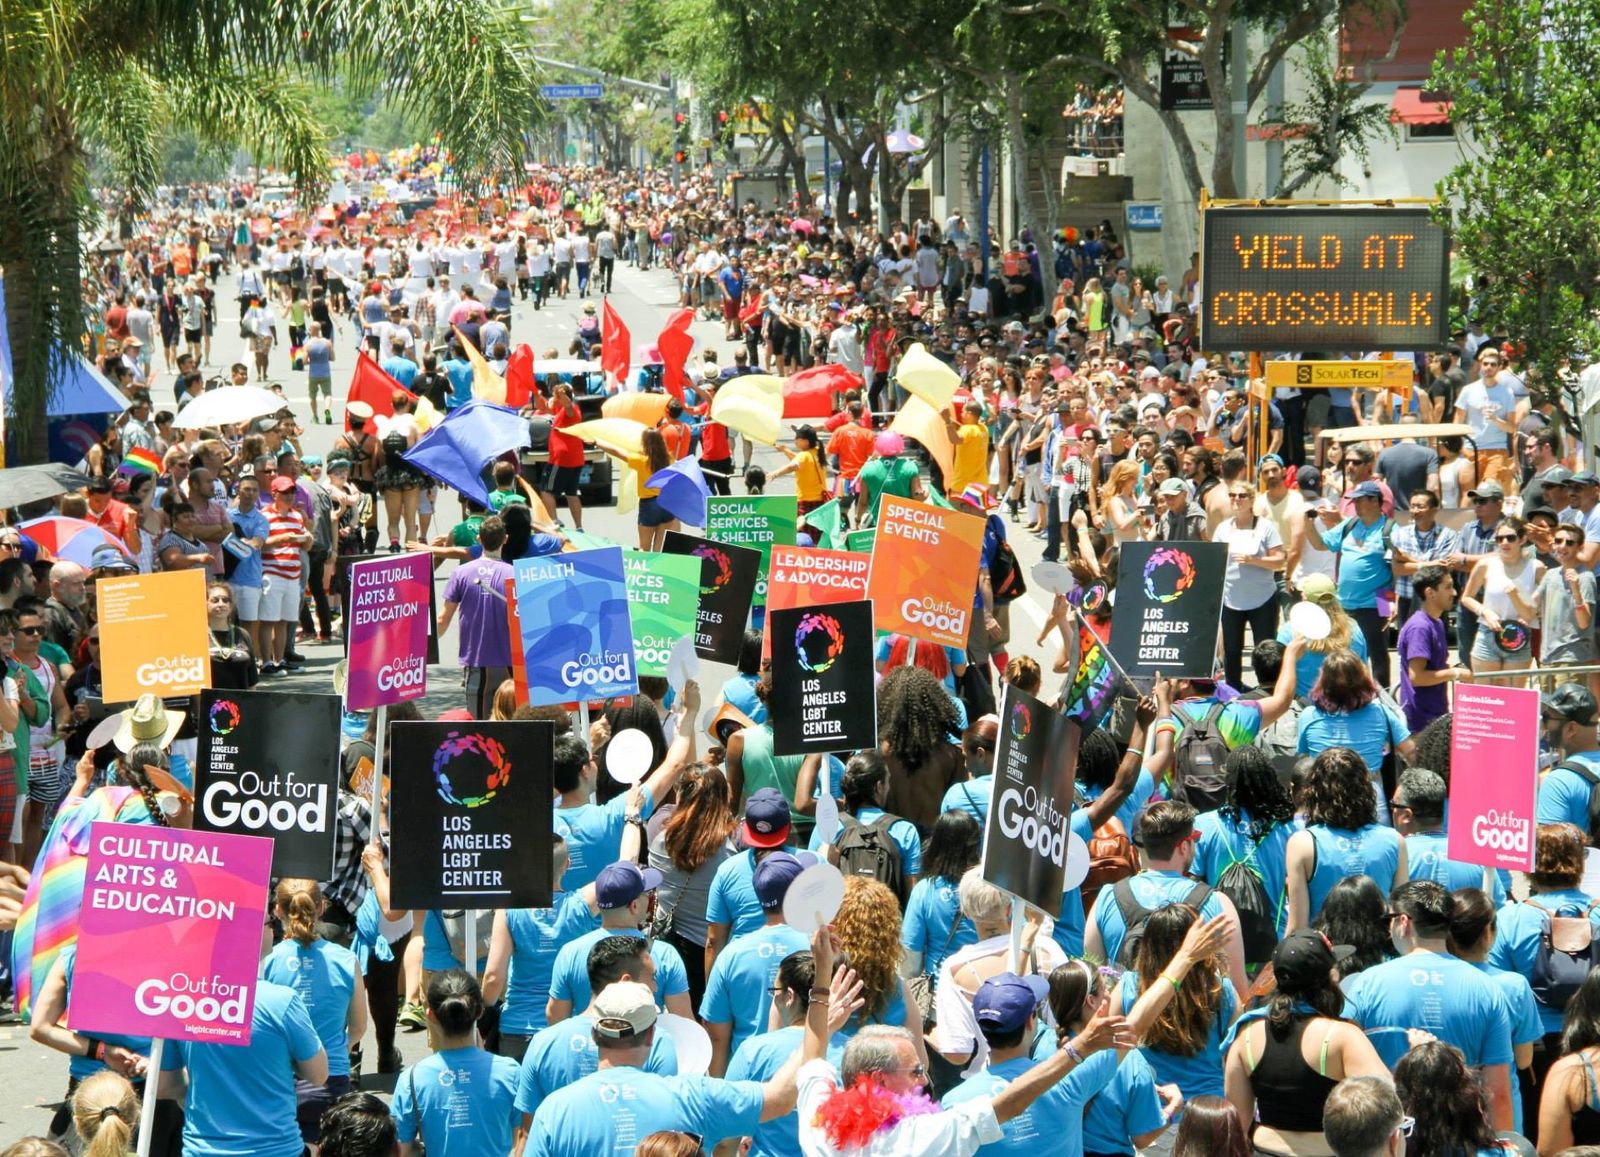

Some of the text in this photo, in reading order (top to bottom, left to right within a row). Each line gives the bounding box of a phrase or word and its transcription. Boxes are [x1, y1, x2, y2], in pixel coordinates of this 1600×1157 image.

[1172, 71, 1192, 83] JUNE
[1233, 233, 1415, 270] YIELD AT
[1212, 290, 1433, 327] CROSSWALK
[710, 503, 757, 515] SOCIAL
[885, 503, 945, 530] SPECIAL
[710, 517, 769, 529] SERVICES
[721, 530, 774, 544] SHELTER
[883, 520, 940, 545] EVENTS
[519, 561, 575, 582] HEALTH
[776, 553, 866, 573] LEADERSHIP
[357, 565, 414, 587] CULTURAL
[774, 569, 785, 582] &
[356, 587, 396, 606] ARTS &
[627, 590, 670, 605] ELTER
[355, 600, 418, 625] EDUCATION
[922, 596, 961, 618] Out for
[1143, 608, 1164, 619] LOS
[901, 598, 966, 635] Good
[1141, 621, 1189, 633] ANGELES
[642, 635, 665, 648] Out
[1140, 634, 1167, 646] LGBT
[155, 655, 197, 668] Out for
[393, 653, 420, 670] Out for
[579, 649, 621, 666] Out for
[1138, 647, 1179, 659] CENTER
[136, 657, 205, 687] Good
[377, 656, 424, 691] Good
[561, 653, 631, 688] Good
[802, 679, 820, 692] LOS
[803, 691, 846, 707] ANGELES
[803, 707, 827, 721] LGBT
[803, 720, 841, 735] CENTER
[212, 737, 224, 745] LOS
[210, 754, 226, 762] LGBT
[211, 746, 239, 754] ANGELES
[210, 762, 235, 770] CENTER
[239, 771, 317, 798] Out for
[203, 780, 328, 833] Good
[1024, 785, 1063, 829] Out for
[442, 816, 472, 831] LOS
[1487, 808, 1522, 830] Out for
[998, 788, 1067, 868] Good
[1472, 815, 1530, 853] Good
[442, 834, 512, 850] ANGELES
[99, 836, 225, 867] CULTURAL
[442, 852, 482, 868] LGBT
[95, 863, 178, 889] ARTS &
[442, 871, 503, 886] CENTER
[91, 888, 236, 921] EDUCATION
[170, 972, 239, 997] Out for
[134, 978, 249, 1024] Good
